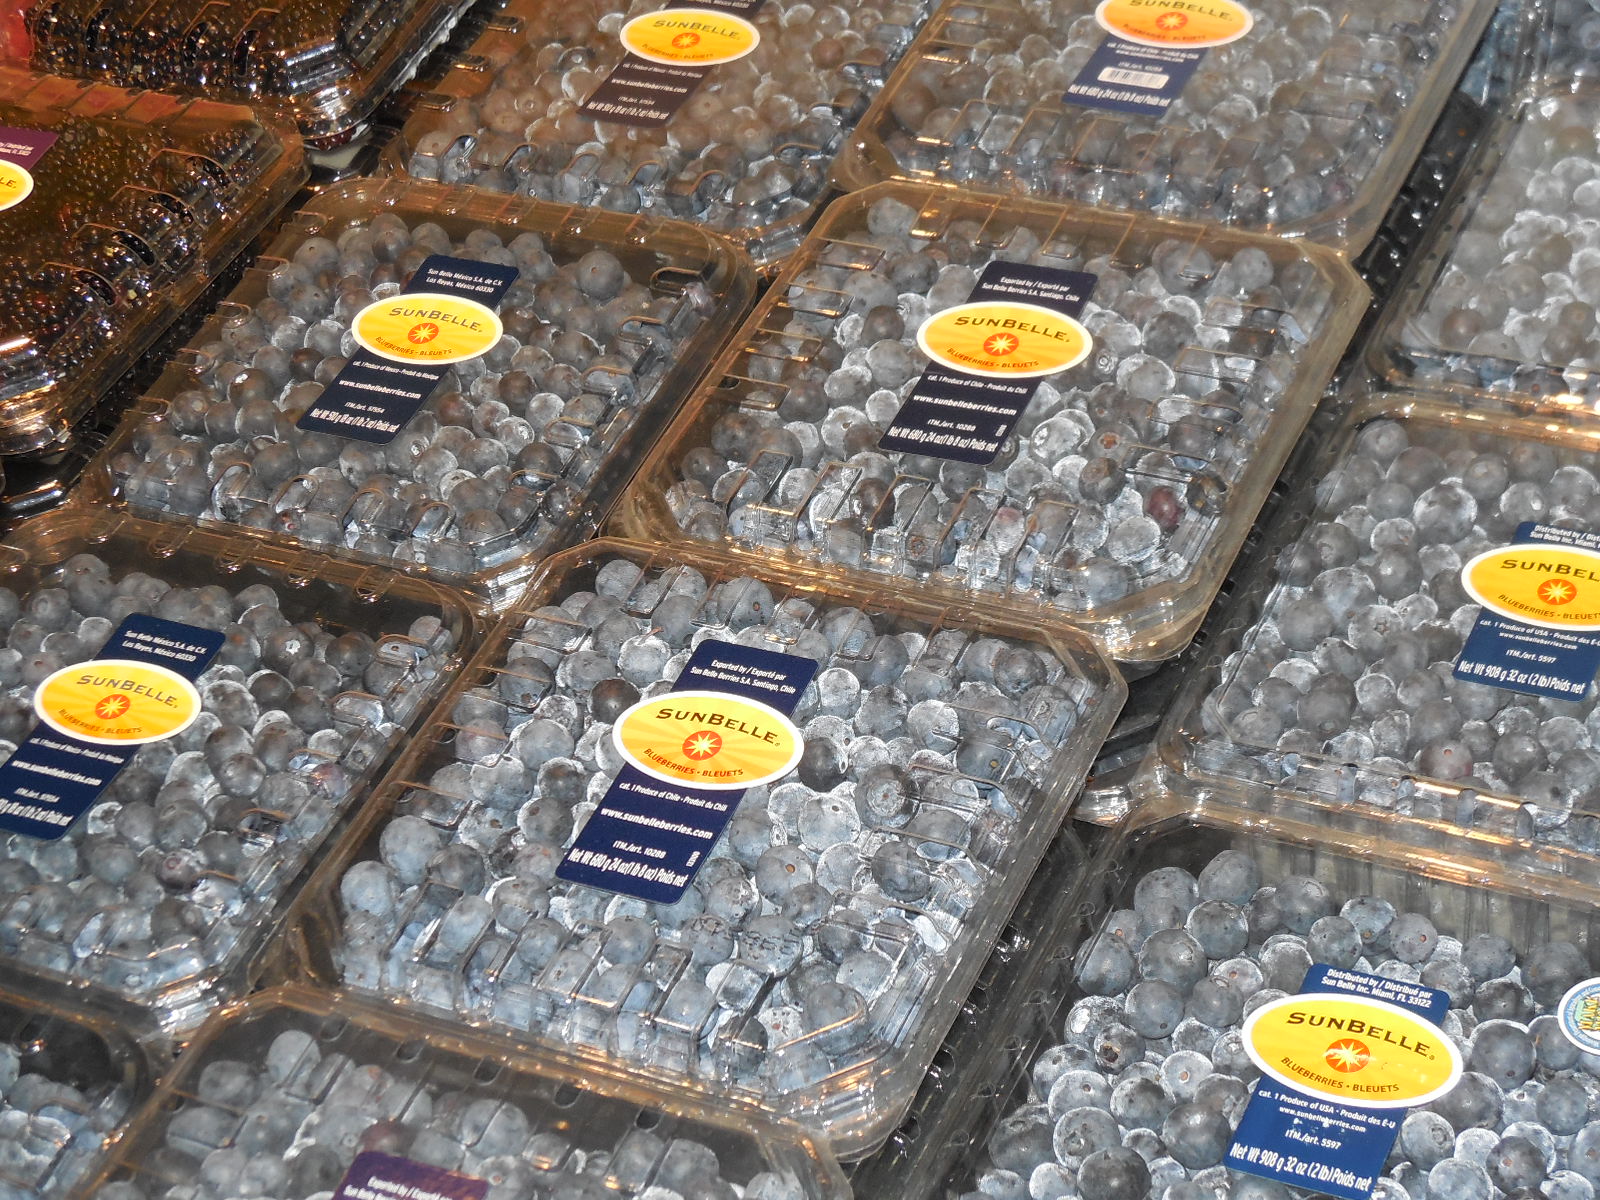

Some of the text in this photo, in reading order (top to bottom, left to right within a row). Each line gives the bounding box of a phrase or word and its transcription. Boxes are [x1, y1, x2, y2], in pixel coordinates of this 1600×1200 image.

[389, 307, 480, 332] SUNBELLE
[955, 316, 1069, 341] SUNBELLE
[913, 395, 1017, 415] www.sunbelleberries.com
[690, 666, 796, 694] Sun Belle Berries S.A. Santiago, Chile
[711, 659, 740, 671] Exported
[738, 665, 747, 674] by
[751, 667, 776, 679] Exporté
[1458, 660, 1474, 673] Net
[1473, 663, 1485, 675] Wt
[1484, 665, 1502, 678] 908
[1506, 669, 1519, 682] 32
[1517, 673, 1528, 684] oz
[1549, 677, 1571, 692] Poids
[1570, 683, 1586, 694] net
[76, 675, 176, 706] SUNBELLE
[656, 708, 778, 744] SUNBELLE
[643, 748, 744, 778] BLUEBERRIES BLEUETS
[634, 785, 659, 796] Produce
[665, 792, 681, 801] Chile
[683, 796, 706, 807] Produit
[704, 801, 713, 809] du
[713, 802, 728, 811] Chili
[601, 808, 713, 839] www.sunbelleberries.com
[612, 840, 666, 859] ITM./art. 10288
[567, 848, 585, 862] Net
[580, 851, 594, 865] Wt
[589, 853, 607, 868] 680
[607, 857, 622, 871] 24
[630, 863, 641, 876] lb
[643, 867, 659, 881] oz)
[654, 868, 676, 884] Poids
[672, 874, 689, 887] net
[1321, 976, 1432, 1008] Sun Belle Inc. Miami, FL 33122
[1326, 968, 1432, 999] Distributed by Distribué par
[1286, 1012, 1430, 1057] SUNBELLE
[1281, 1056, 1400, 1093] BLUEBERRIES BLEUETS
[1258, 1090, 1271, 1098] cat.
[1279, 1094, 1309, 1107] Produce
[1309, 1102, 1319, 1110] of
[1319, 1104, 1334, 1114] USA
[1340, 1109, 1367, 1122] Produit
[1367, 1116, 1381, 1125] des
[1285, 1129, 1341, 1149] ITM./art. 5597
[1229, 1142, 1248, 1160] Net
[1247, 1146, 1260, 1163] Wt
[1258, 1149, 1279, 1167] 908
[1283, 1156, 1298, 1172] 32
[1295, 1162, 1308, 1175] oz
[1330, 1168, 1356, 1188] Poids
[1354, 1177, 1372, 1192] net
